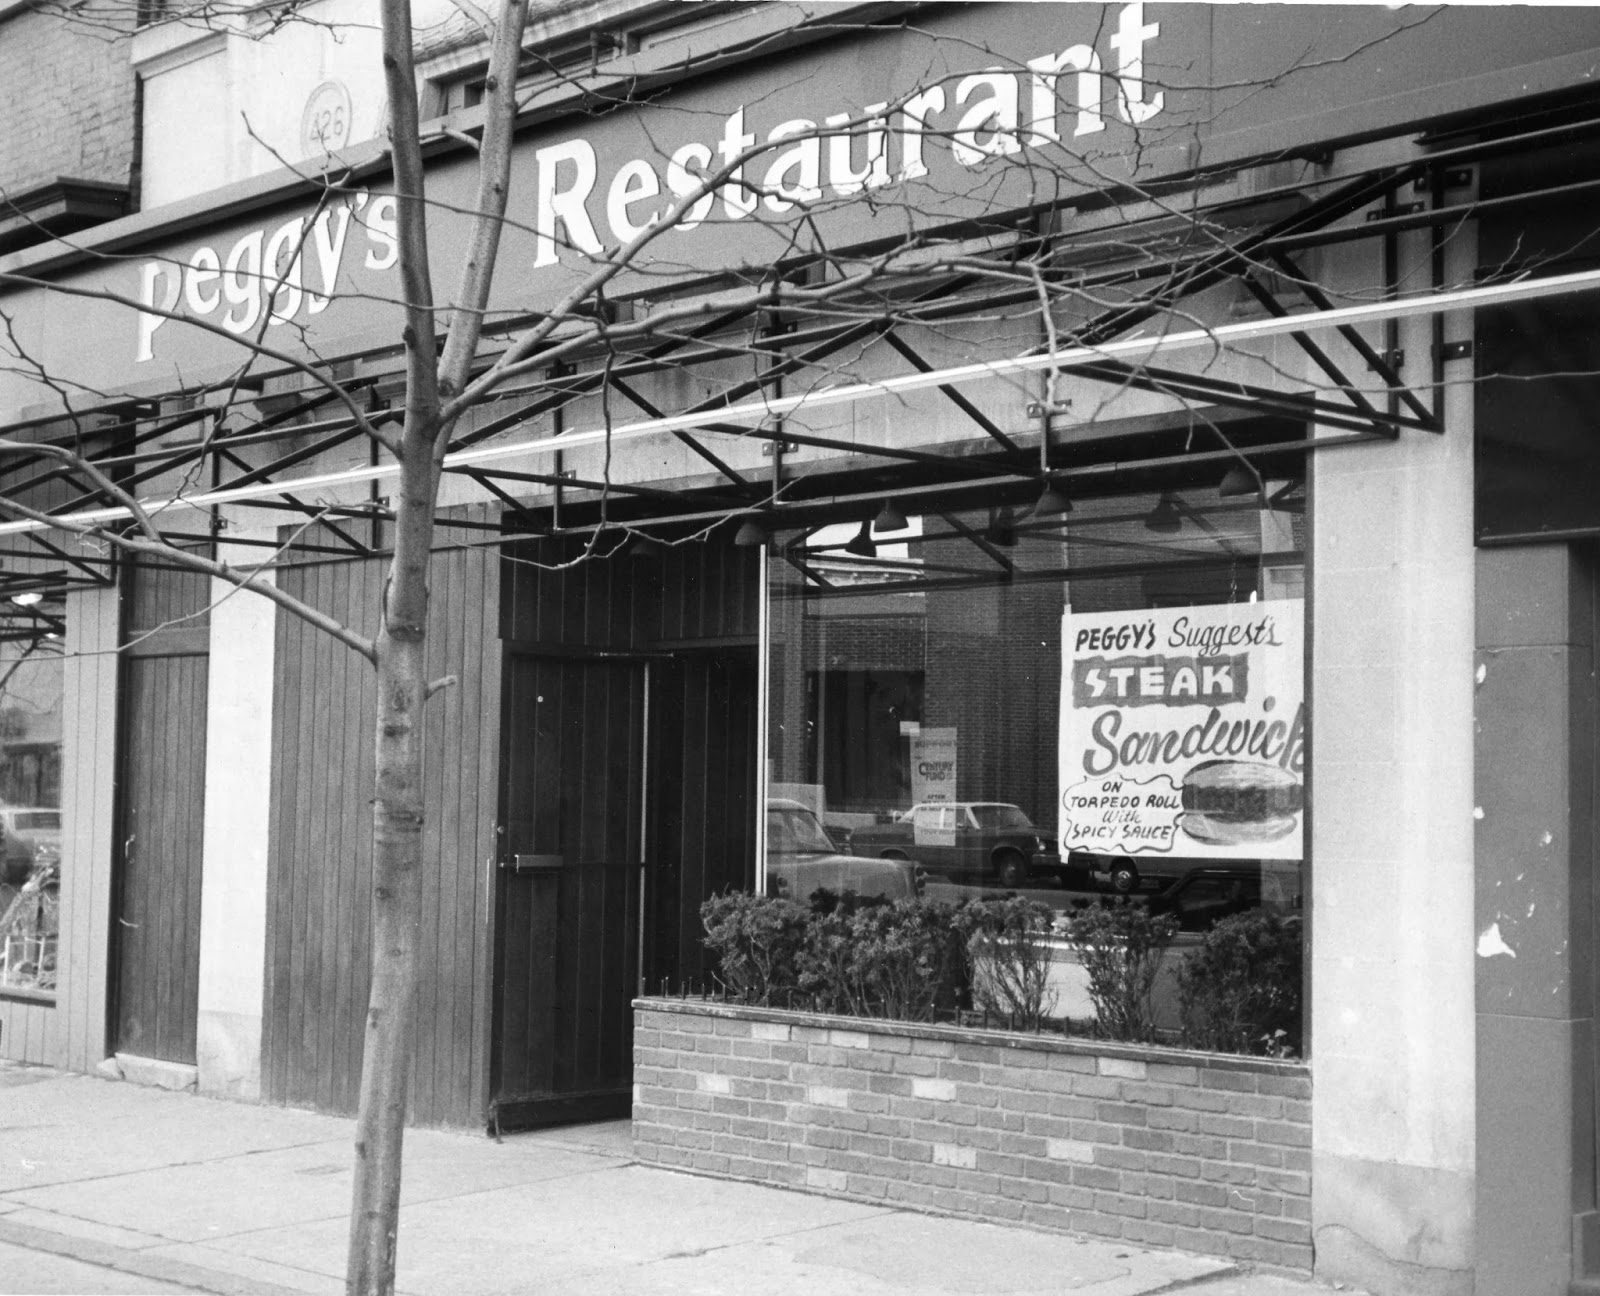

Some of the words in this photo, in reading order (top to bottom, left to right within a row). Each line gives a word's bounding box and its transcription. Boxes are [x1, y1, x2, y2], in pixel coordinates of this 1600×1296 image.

[534, 4, 1165, 268] Restaurant
[1075, 619, 1156, 651] PEGGY'S
[1085, 665, 1234, 698] STEAK
[1101, 781, 1123, 793] ON
[1071, 795, 1141, 808] TORPEDO
[1146, 795, 1180, 808] ROLL
[1102, 809, 1142, 823] With
[1072, 824, 1116, 839] SPICY
[1122, 824, 1173, 839] SAUCE
